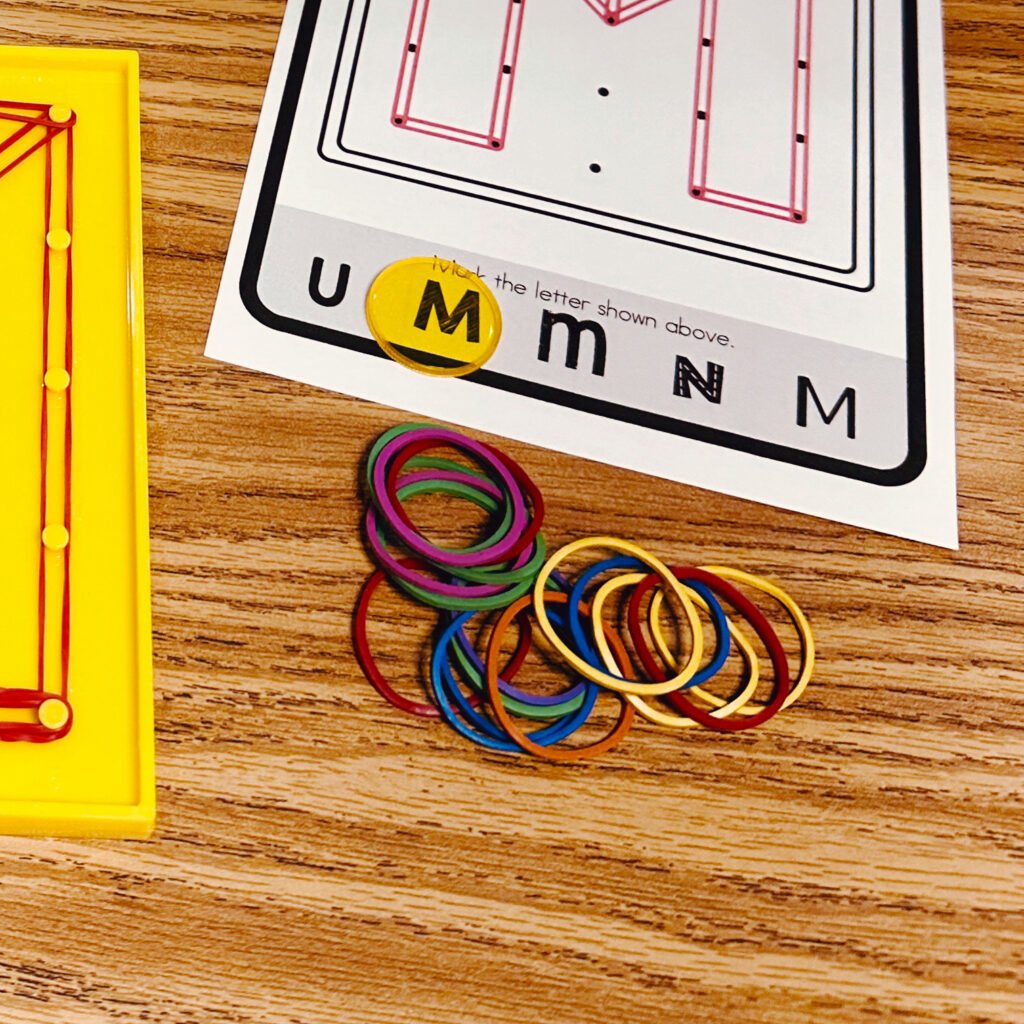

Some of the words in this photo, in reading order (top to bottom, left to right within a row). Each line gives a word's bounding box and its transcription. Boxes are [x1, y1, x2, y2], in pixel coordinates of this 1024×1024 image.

[413, 279, 480, 344] M
[537, 308, 607, 377] m
[673, 354, 725, 405] N
[796, 375, 856, 440] M
[494, 272, 527, 295] the
[535, 280, 591, 310] letter
[597, 299, 657, 329] shown
[665, 316, 735, 349] above.
